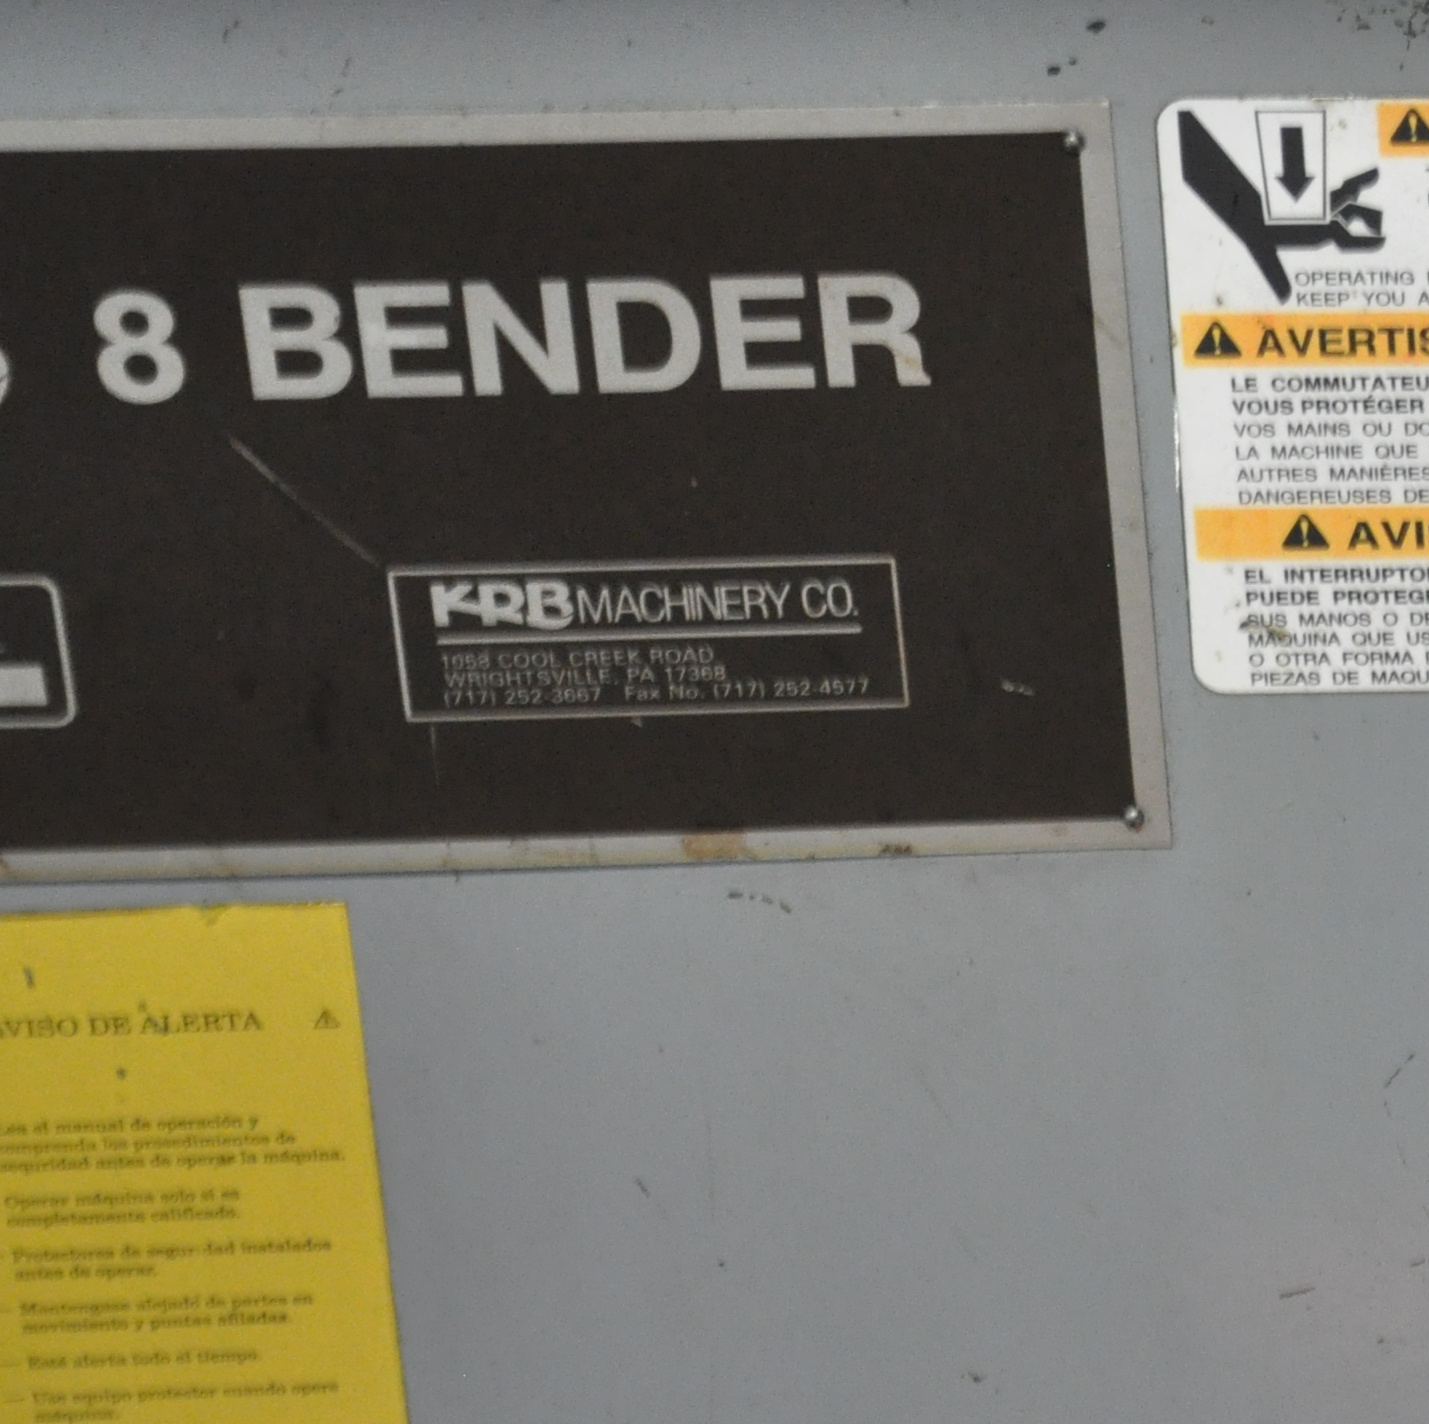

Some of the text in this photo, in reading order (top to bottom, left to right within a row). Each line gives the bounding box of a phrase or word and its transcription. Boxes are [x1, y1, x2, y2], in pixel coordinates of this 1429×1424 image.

[1293, 269, 1415, 286] OPERATING
[1296, 290, 1350, 305] KEEP
[1364, 290, 1405, 305] YOU
[92, 271, 931, 405] 8 BENDER
[1230, 376, 1258, 392] LE
[1231, 398, 1294, 414] VOUS
[1299, 392, 1425, 413] PROTÉGER
[1232, 421, 1276, 437] VOS
[1285, 421, 1351, 436] MAINS
[1361, 421, 1393, 436] OU
[1234, 444, 1259, 459] LA
[1269, 443, 1363, 459] MACHINE
[1373, 443, 1418, 458] QUE
[1235, 466, 1318, 482] AUTRES
[1237, 488, 1392, 504] DANGEREUSES
[1243, 567, 1271, 582] EL
[429, 577, 860, 631] KRB MACHINERY CO.
[1244, 589, 1320, 604] PUEDE
[497, 649, 562, 669] COOL
[569, 647, 642, 667] CREEK
[649, 644, 715, 665] ROAD
[1247, 651, 1265, 666] O
[1274, 650, 1331, 666] OTRA
[1341, 650, 1414, 665] FORMA
[626, 666, 656, 684] PA
[665, 664, 727, 683] 17368
[1249, 670, 1321, 685] PIEZAS
[1331, 669, 1359, 684] DE
[443, 690, 496, 708] (717)
[624, 685, 660, 702] Fax
[668, 683, 705, 700] No.
[712, 680, 766, 699] (717)
[0, 1010, 264, 1039] VISO DE ALERTA
